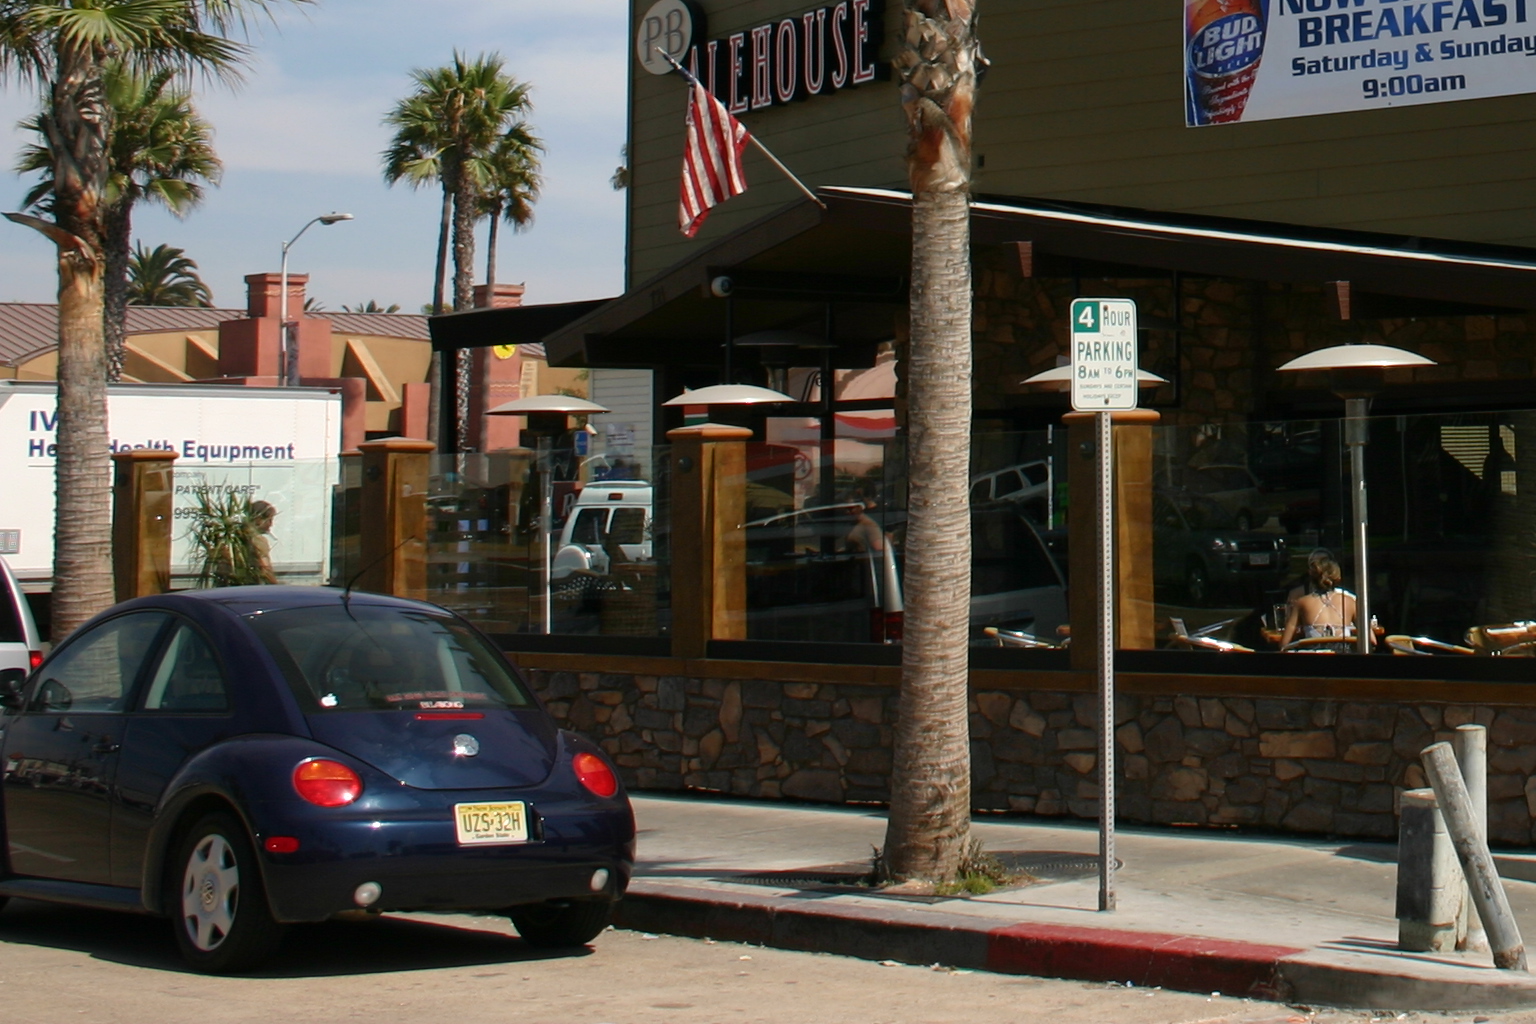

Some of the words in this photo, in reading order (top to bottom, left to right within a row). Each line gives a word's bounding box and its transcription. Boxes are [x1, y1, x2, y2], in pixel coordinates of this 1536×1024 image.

[643, 8, 684, 65] PB
[1203, 16, 1258, 48] BUD
[1195, 31, 1262, 68] LIGHT
[1291, 48, 1409, 77] Saturday
[1414, 42, 1434, 63] &
[1362, 73, 1466, 99] 9:00am
[1078, 306, 1095, 328] 4
[1103, 310, 1131, 326] HOUR
[1078, 341, 1132, 361] PARKING
[182, 440, 295, 462] Equipment
